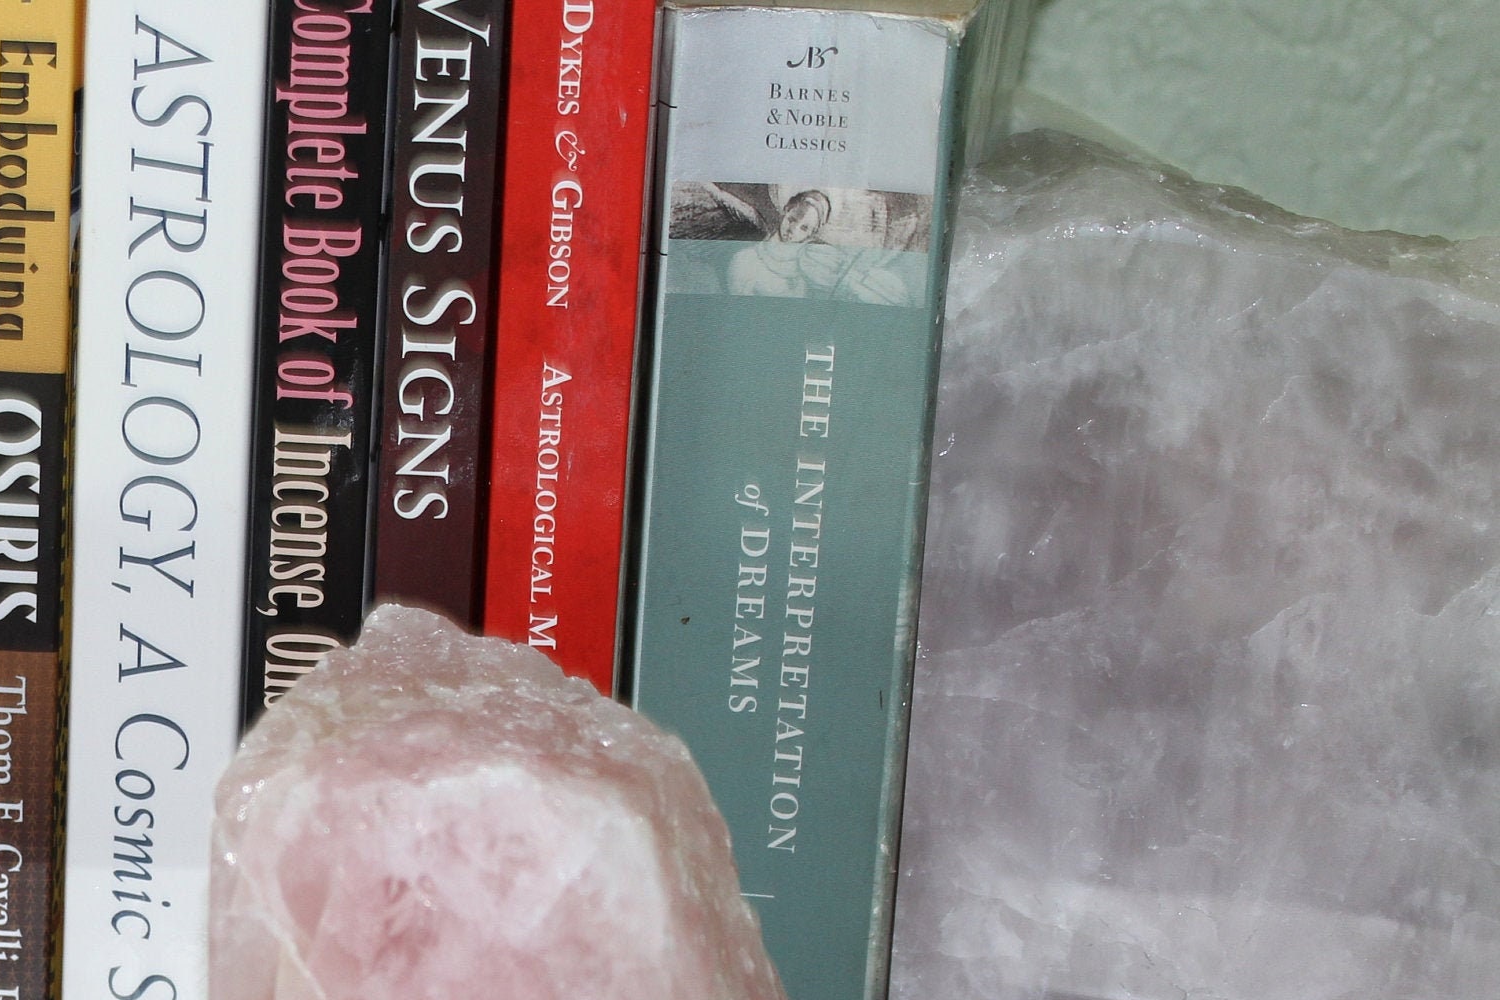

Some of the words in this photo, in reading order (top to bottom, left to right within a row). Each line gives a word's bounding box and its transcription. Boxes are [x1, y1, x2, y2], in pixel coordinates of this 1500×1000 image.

[556, 0, 594, 115] DYKES
[768, 83, 851, 103] BARNES
[555, 130, 586, 171] &
[765, 133, 847, 153] CLASSICS
[766, 109, 783, 125] &
[786, 109, 849, 129] NOBLE
[278, 223, 362, 344] Book
[546, 180, 583, 309] GIBSON
[111, 14, 214, 599] ASTROLOGY,
[276, 360, 354, 410] of
[393, 285, 477, 520] SIGNS
[800, 346, 835, 438] THE
[255, 428, 352, 617] Incense,
[530, 362, 572, 603] ASTROLOGICAL
[734, 483, 769, 517] of
[119, 623, 189, 682] A
[728, 525, 771, 714] DREAMS
[767, 457, 827, 854] INTERPRETATION
[112, 713, 190, 939] Cosmic
